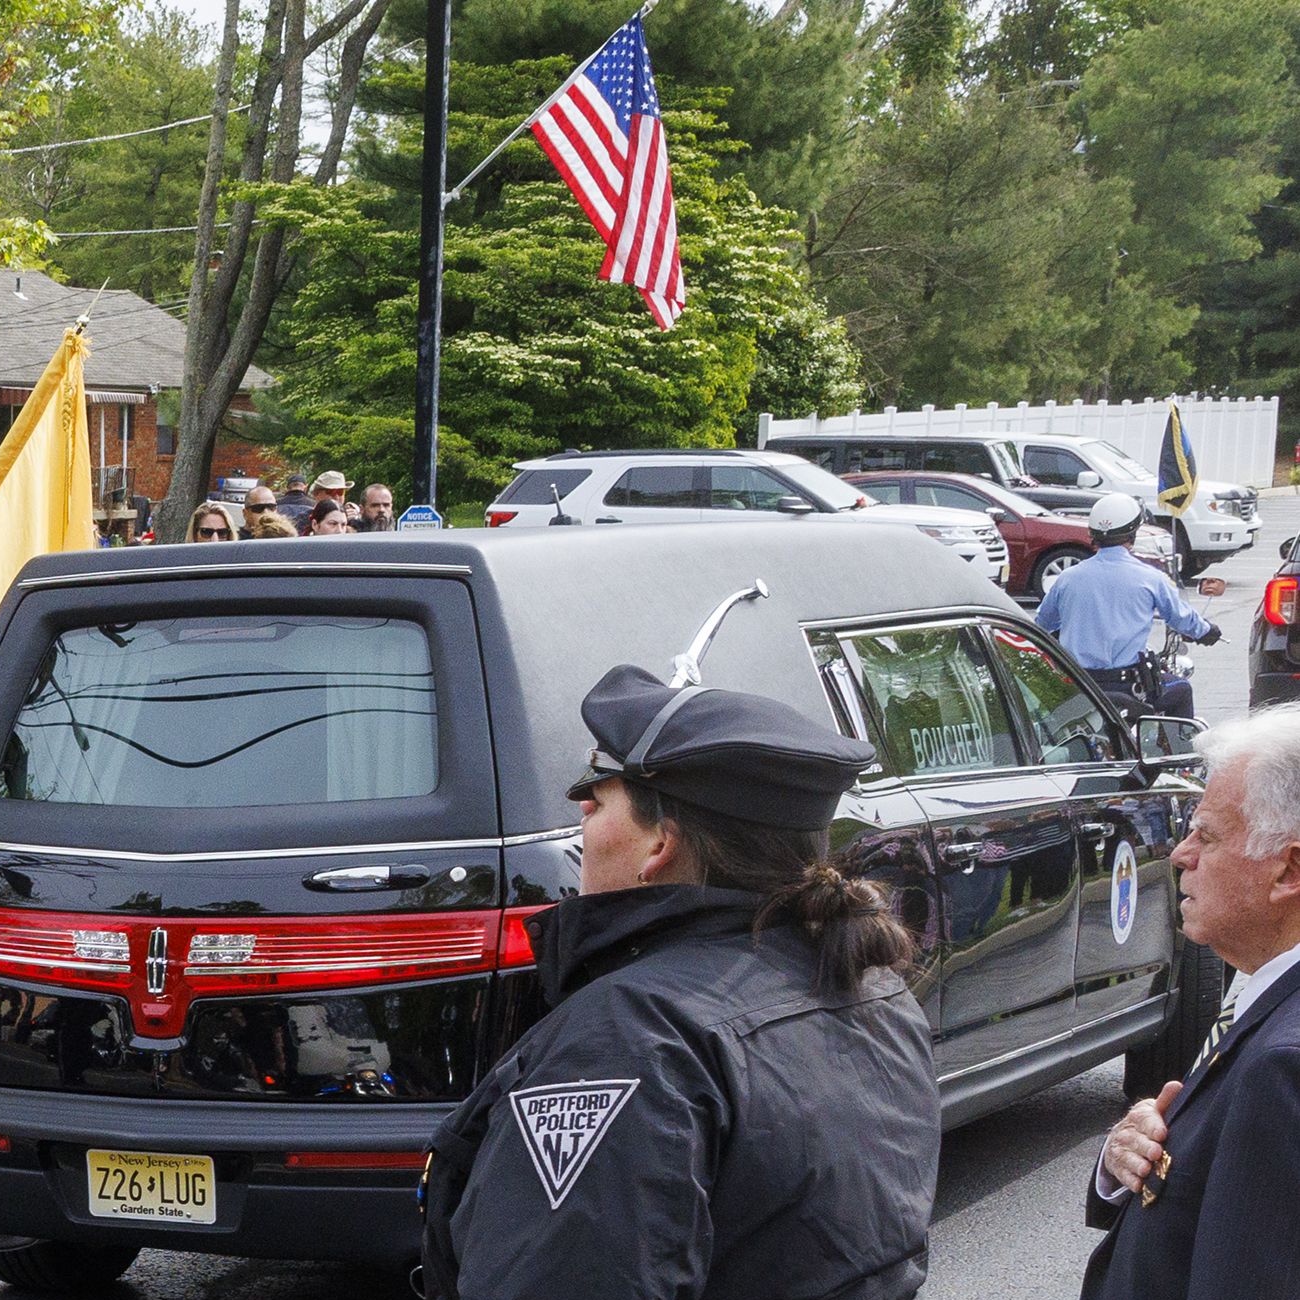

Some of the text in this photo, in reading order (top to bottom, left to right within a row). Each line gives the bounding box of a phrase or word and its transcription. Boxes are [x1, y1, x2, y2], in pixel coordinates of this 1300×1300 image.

[527, 1093, 611, 1116] DEPTFORD
[535, 1111, 599, 1133] POLICE
[117, 1154, 145, 1165] New
[146, 1155, 181, 1170] Jersey
[542, 1132, 585, 1181] NJ
[96, 1167, 206, 1206] Z26 LUG
[120, 1203, 184, 1217] Garden State
